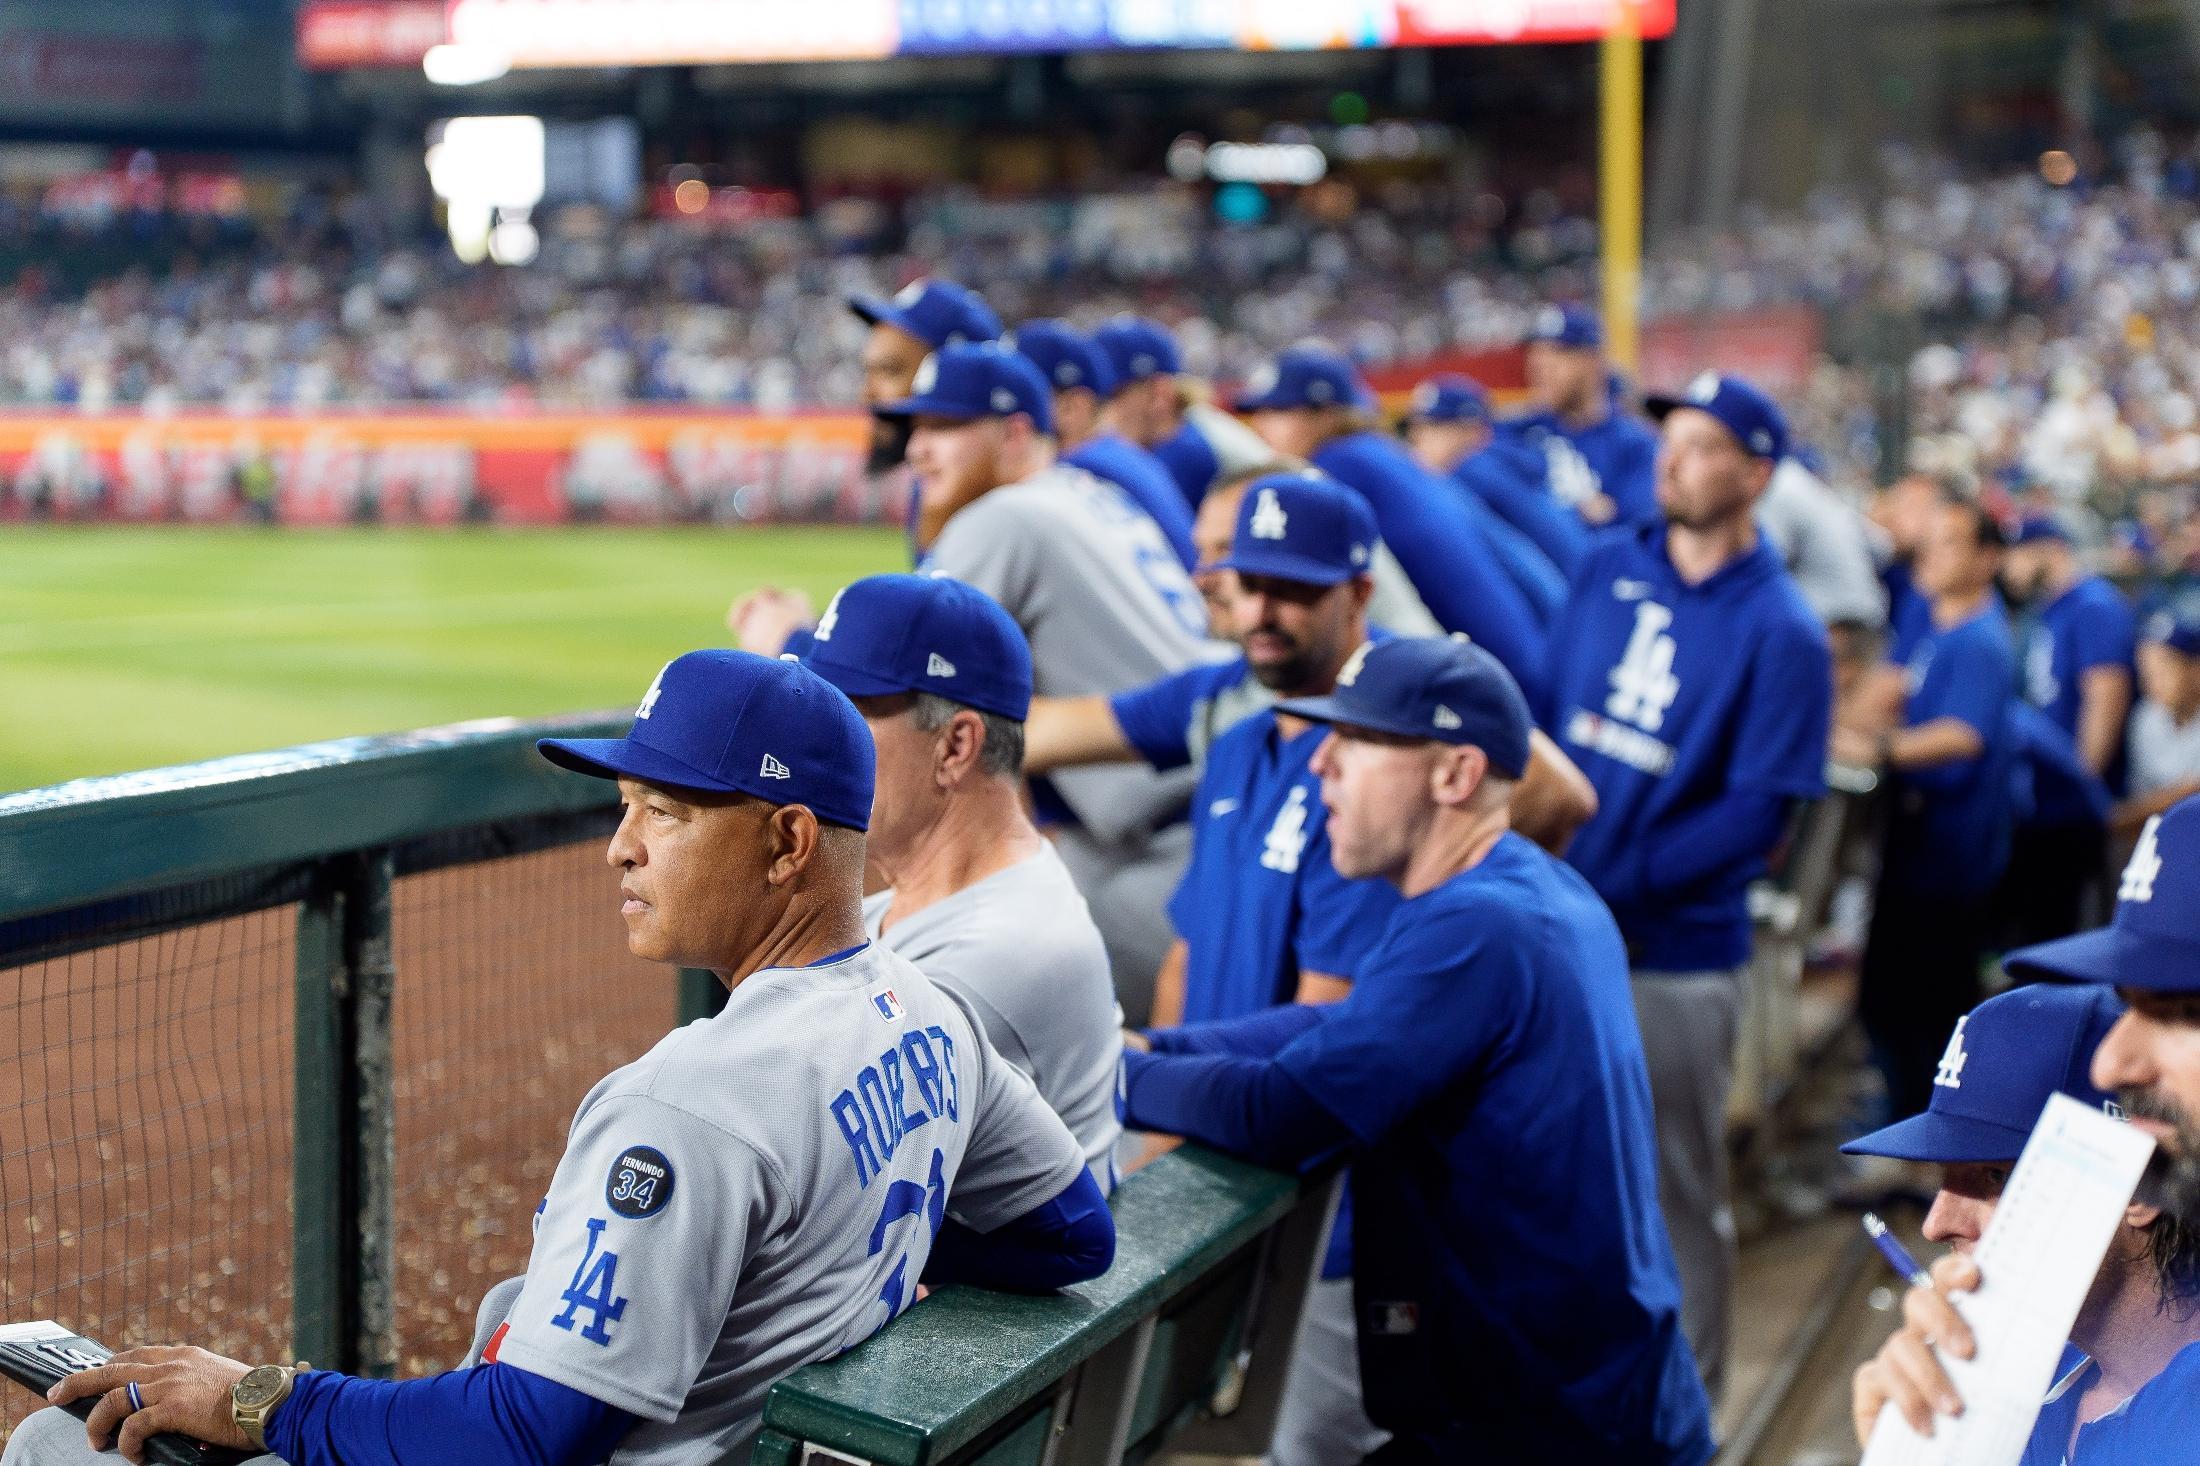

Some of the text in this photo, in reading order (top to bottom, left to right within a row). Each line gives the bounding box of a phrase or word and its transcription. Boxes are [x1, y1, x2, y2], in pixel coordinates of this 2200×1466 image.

[1605, 600, 1681, 733] LA
[1260, 784, 1308, 874] LA
[829, 1025, 958, 1190] ROBERTS
[612, 1169, 658, 1209] 34
[621, 1155, 666, 1178] FERNANDO
[551, 1217, 628, 1347] LA
